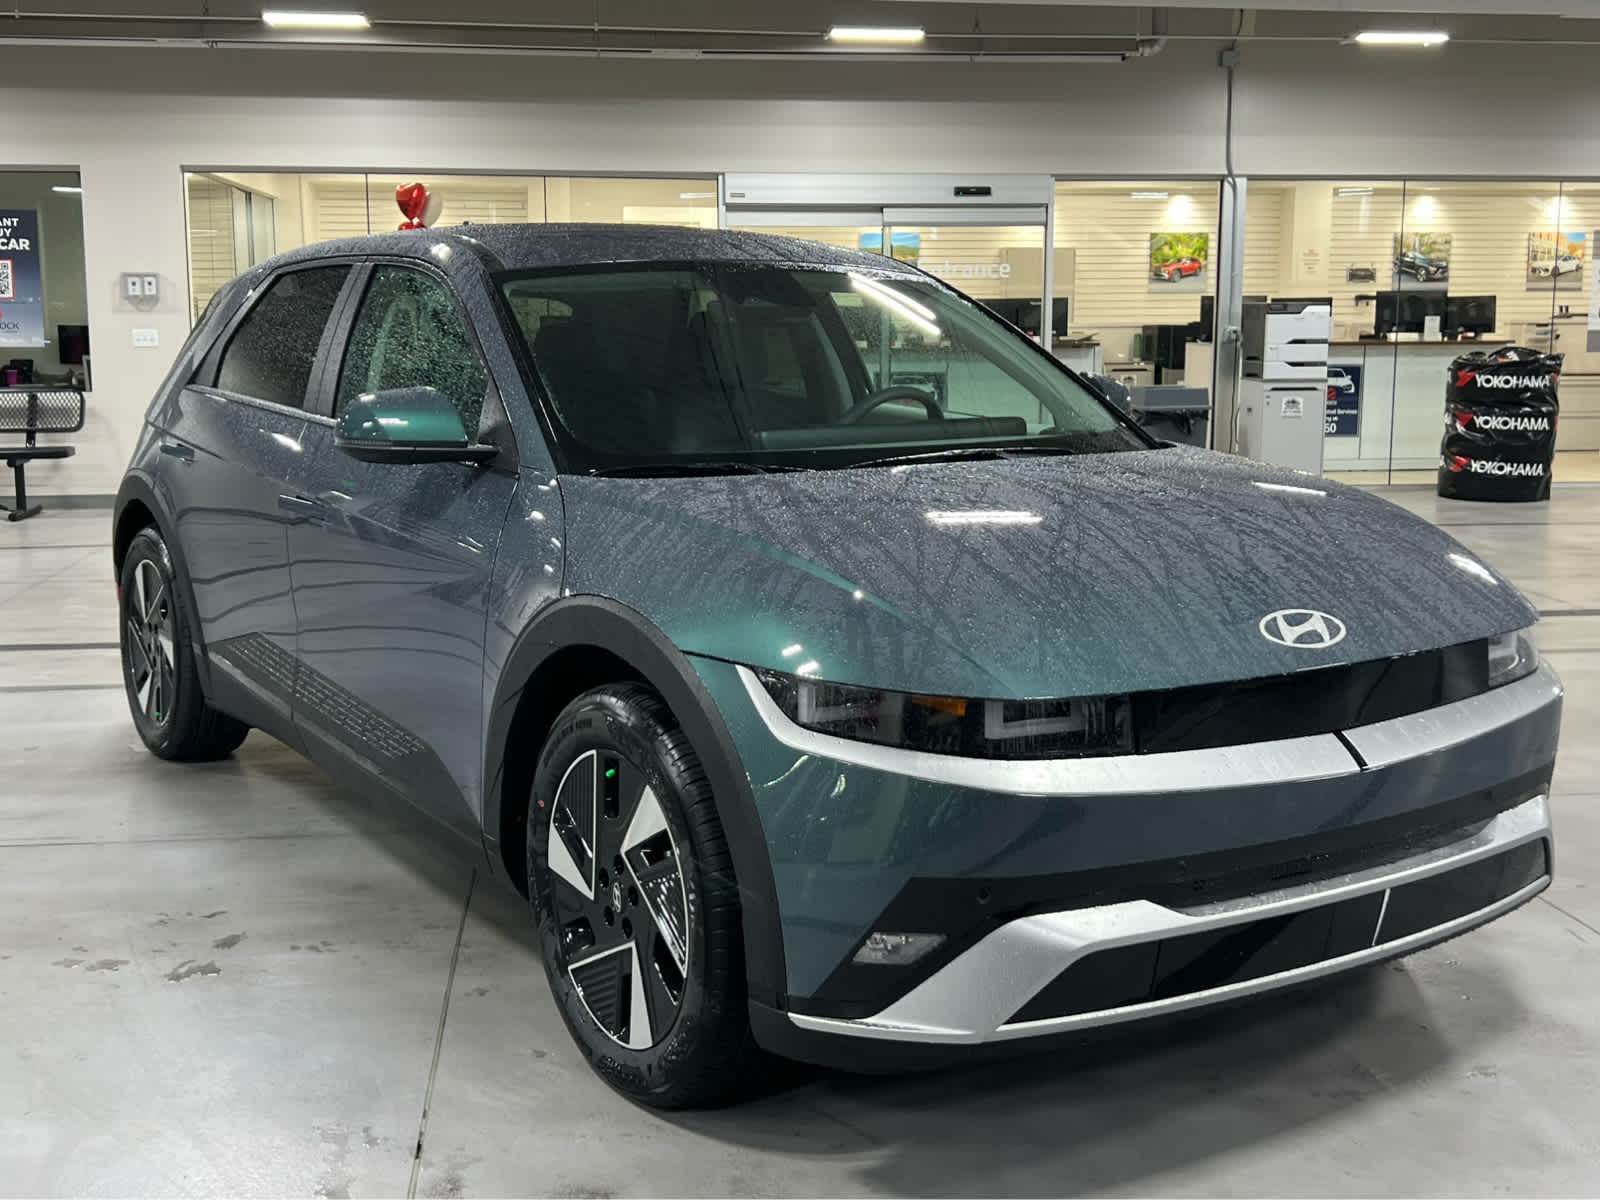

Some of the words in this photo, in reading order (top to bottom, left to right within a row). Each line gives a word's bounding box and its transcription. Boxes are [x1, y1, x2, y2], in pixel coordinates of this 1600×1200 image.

[0, 237, 30, 250] CAR
[1475, 373, 1550, 390] YOKOHAMA
[1472, 415, 1550, 431] YOKOHAMA
[1470, 459, 1545, 477] YOKOHAMA
